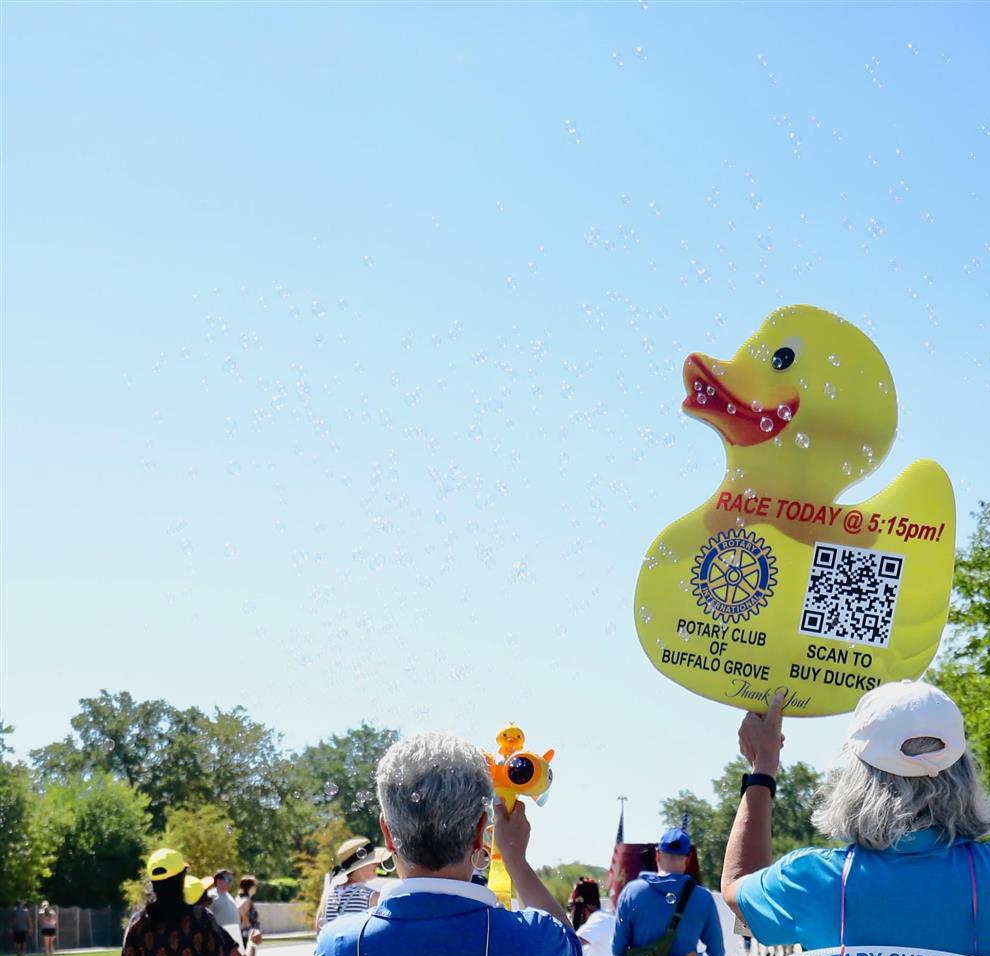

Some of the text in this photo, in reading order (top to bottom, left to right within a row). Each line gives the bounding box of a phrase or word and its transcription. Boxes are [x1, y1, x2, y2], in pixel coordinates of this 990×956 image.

[716, 491, 945, 542] RACE TODAY @ 5:15pm!
[722, 540, 758, 553] ROTARY
[677, 619, 767, 646] ROTARY CLUB
[709, 641, 728, 656] OF
[807, 644, 873, 668] SCAN TO
[662, 649, 770, 681] BUFFALO GROVE
[789, 664, 822, 682] BUY
[725, 679, 770, 702] Thank
